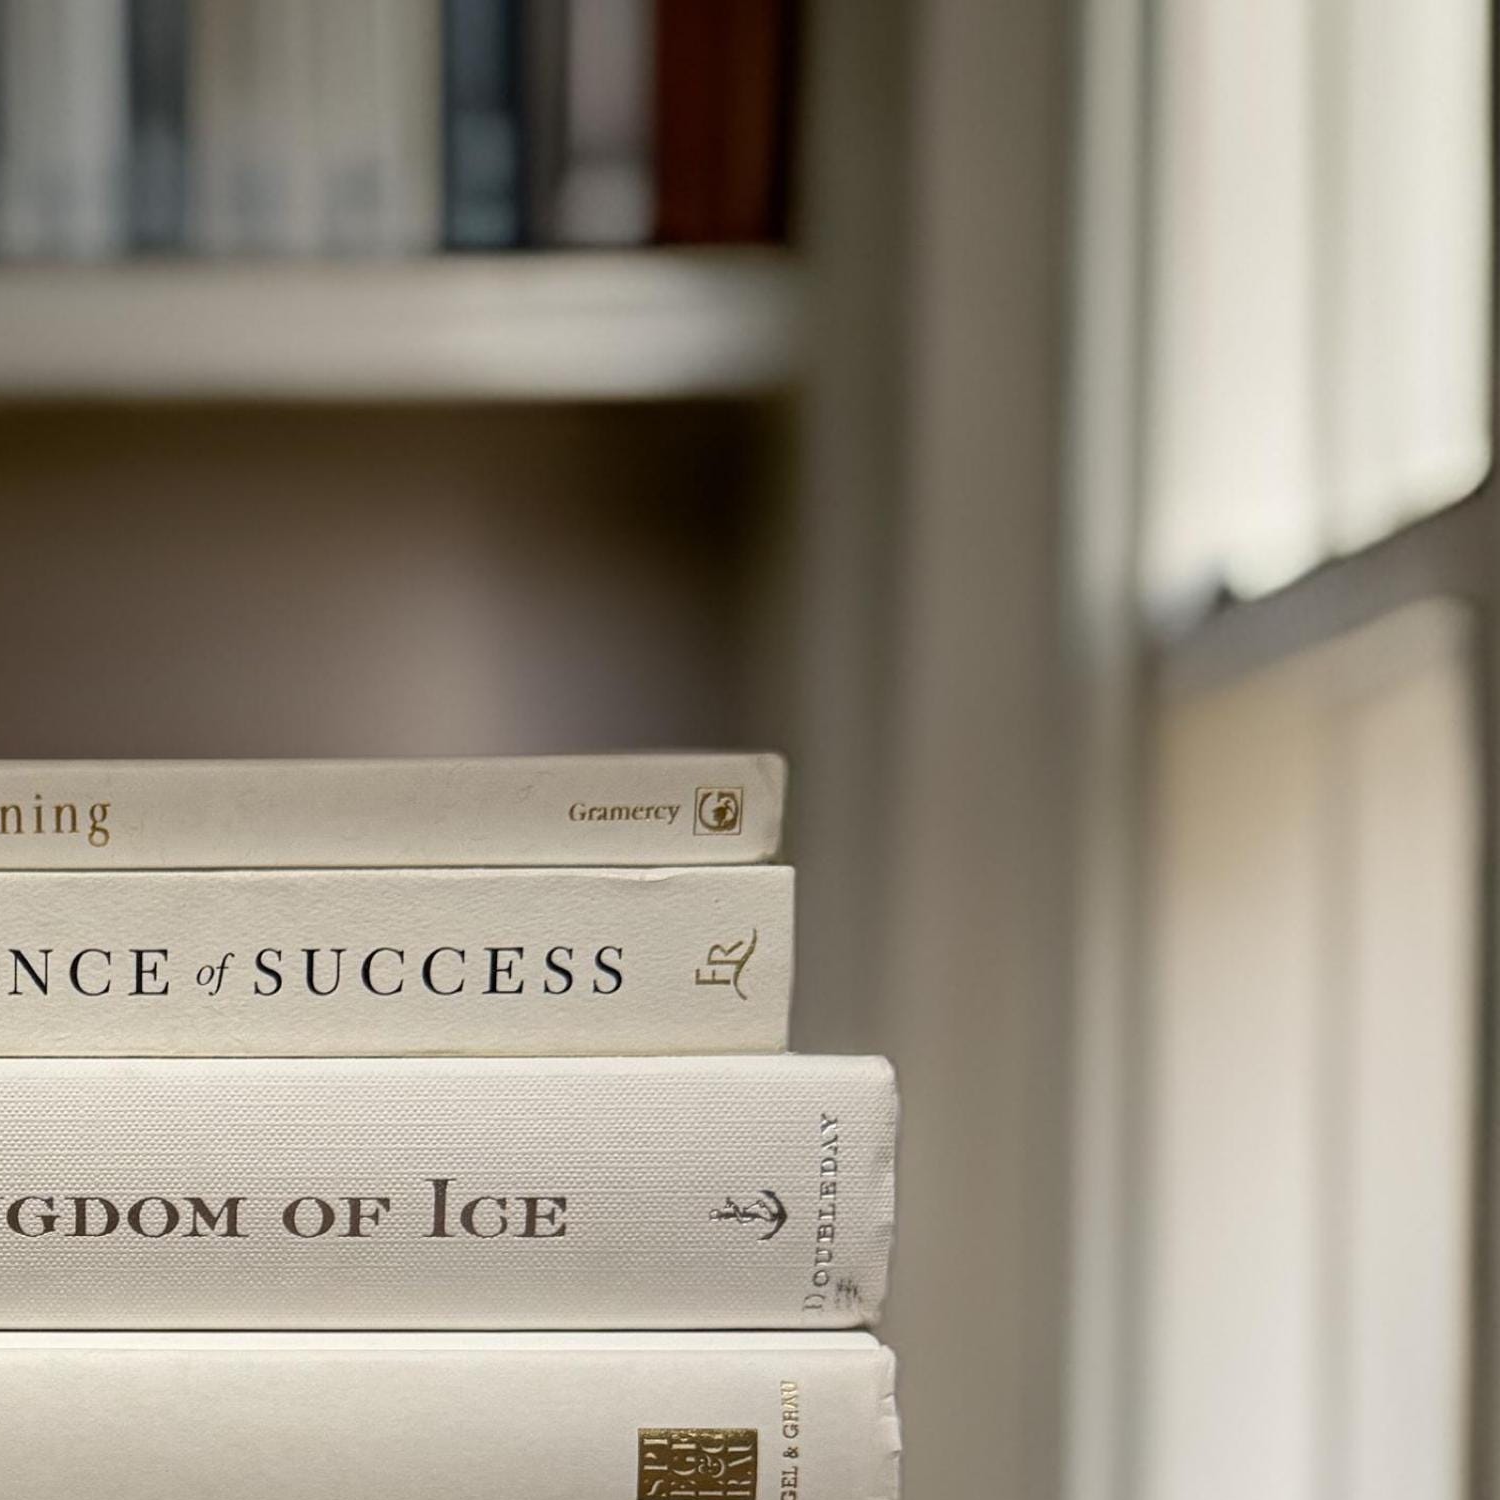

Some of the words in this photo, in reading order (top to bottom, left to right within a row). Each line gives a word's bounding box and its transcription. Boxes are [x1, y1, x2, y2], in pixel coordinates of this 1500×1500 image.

[567, 800, 681, 824] Gramercy
[195, 951, 235, 997] of
[252, 945, 626, 996] SUCCESS
[281, 1196, 392, 1238] OF
[803, 1112, 838, 1314] DOUBLEDAY
[780, 1380, 801, 1440] GRAU
[783, 1447, 800, 1459] &
